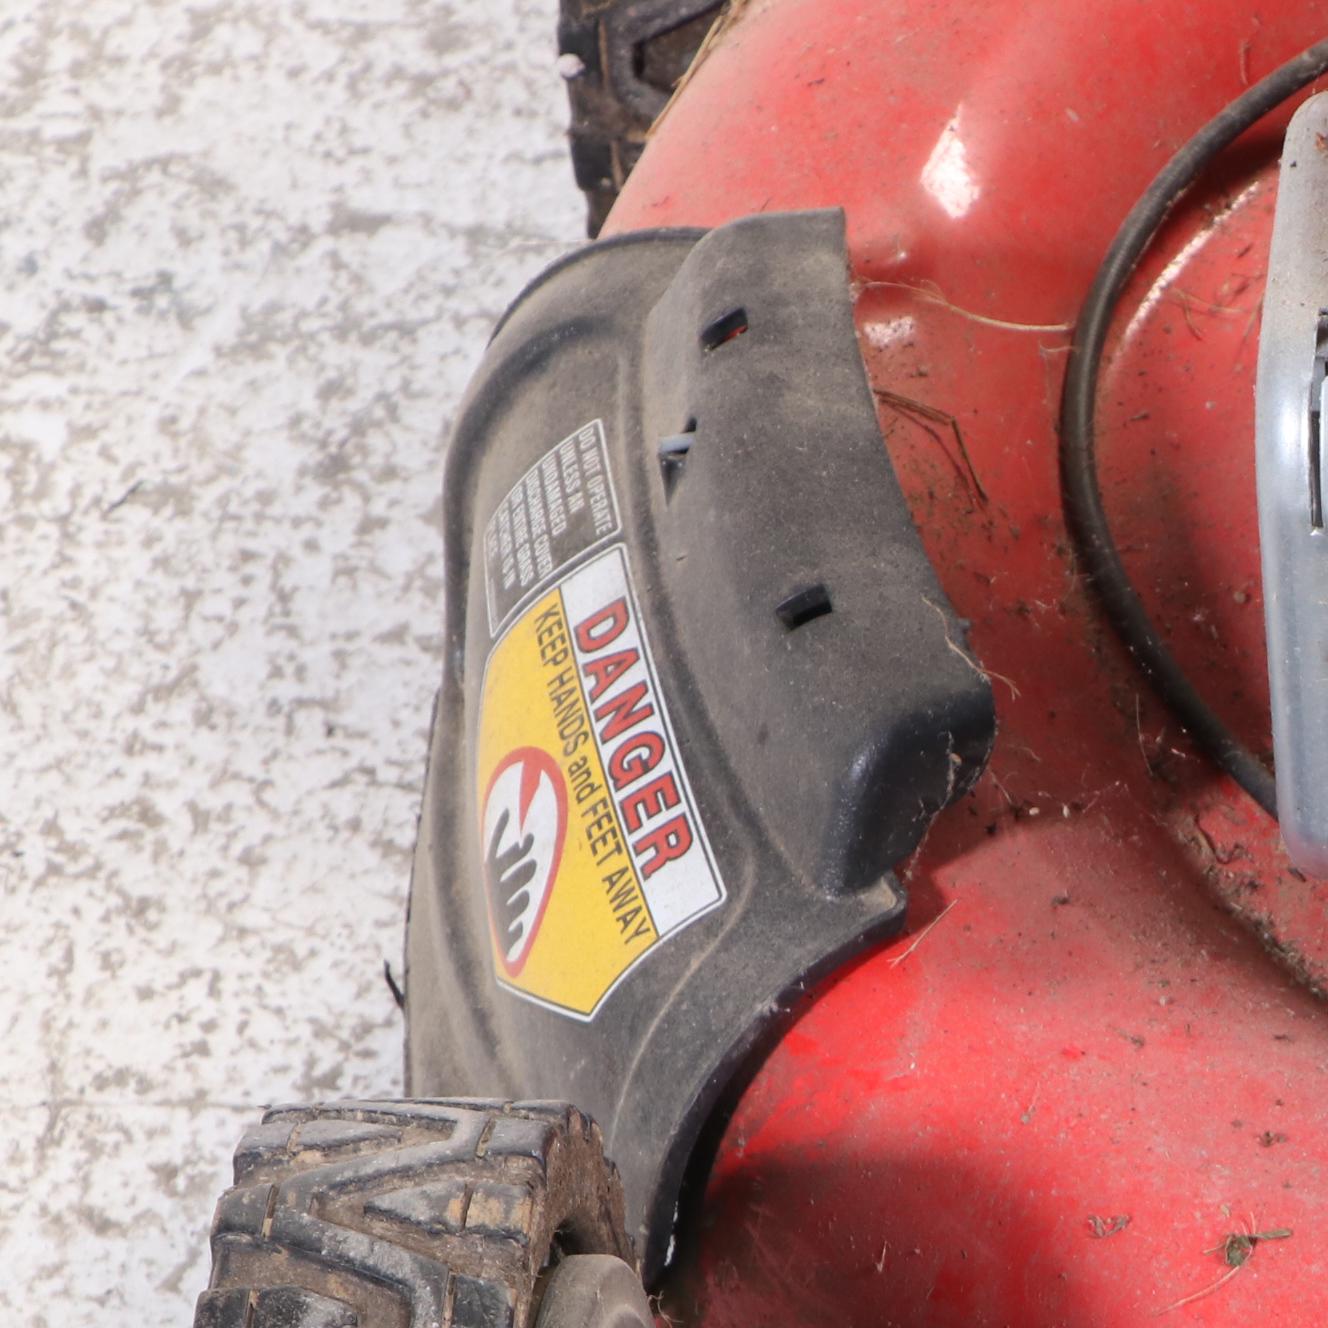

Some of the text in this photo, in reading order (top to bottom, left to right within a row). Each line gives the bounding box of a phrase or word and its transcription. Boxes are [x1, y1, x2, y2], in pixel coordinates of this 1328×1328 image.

[587, 475, 613, 535] OPERATE
[533, 603, 651, 947] KEEP HANDS and FEET AWAY
[574, 597, 695, 879] DANGER
